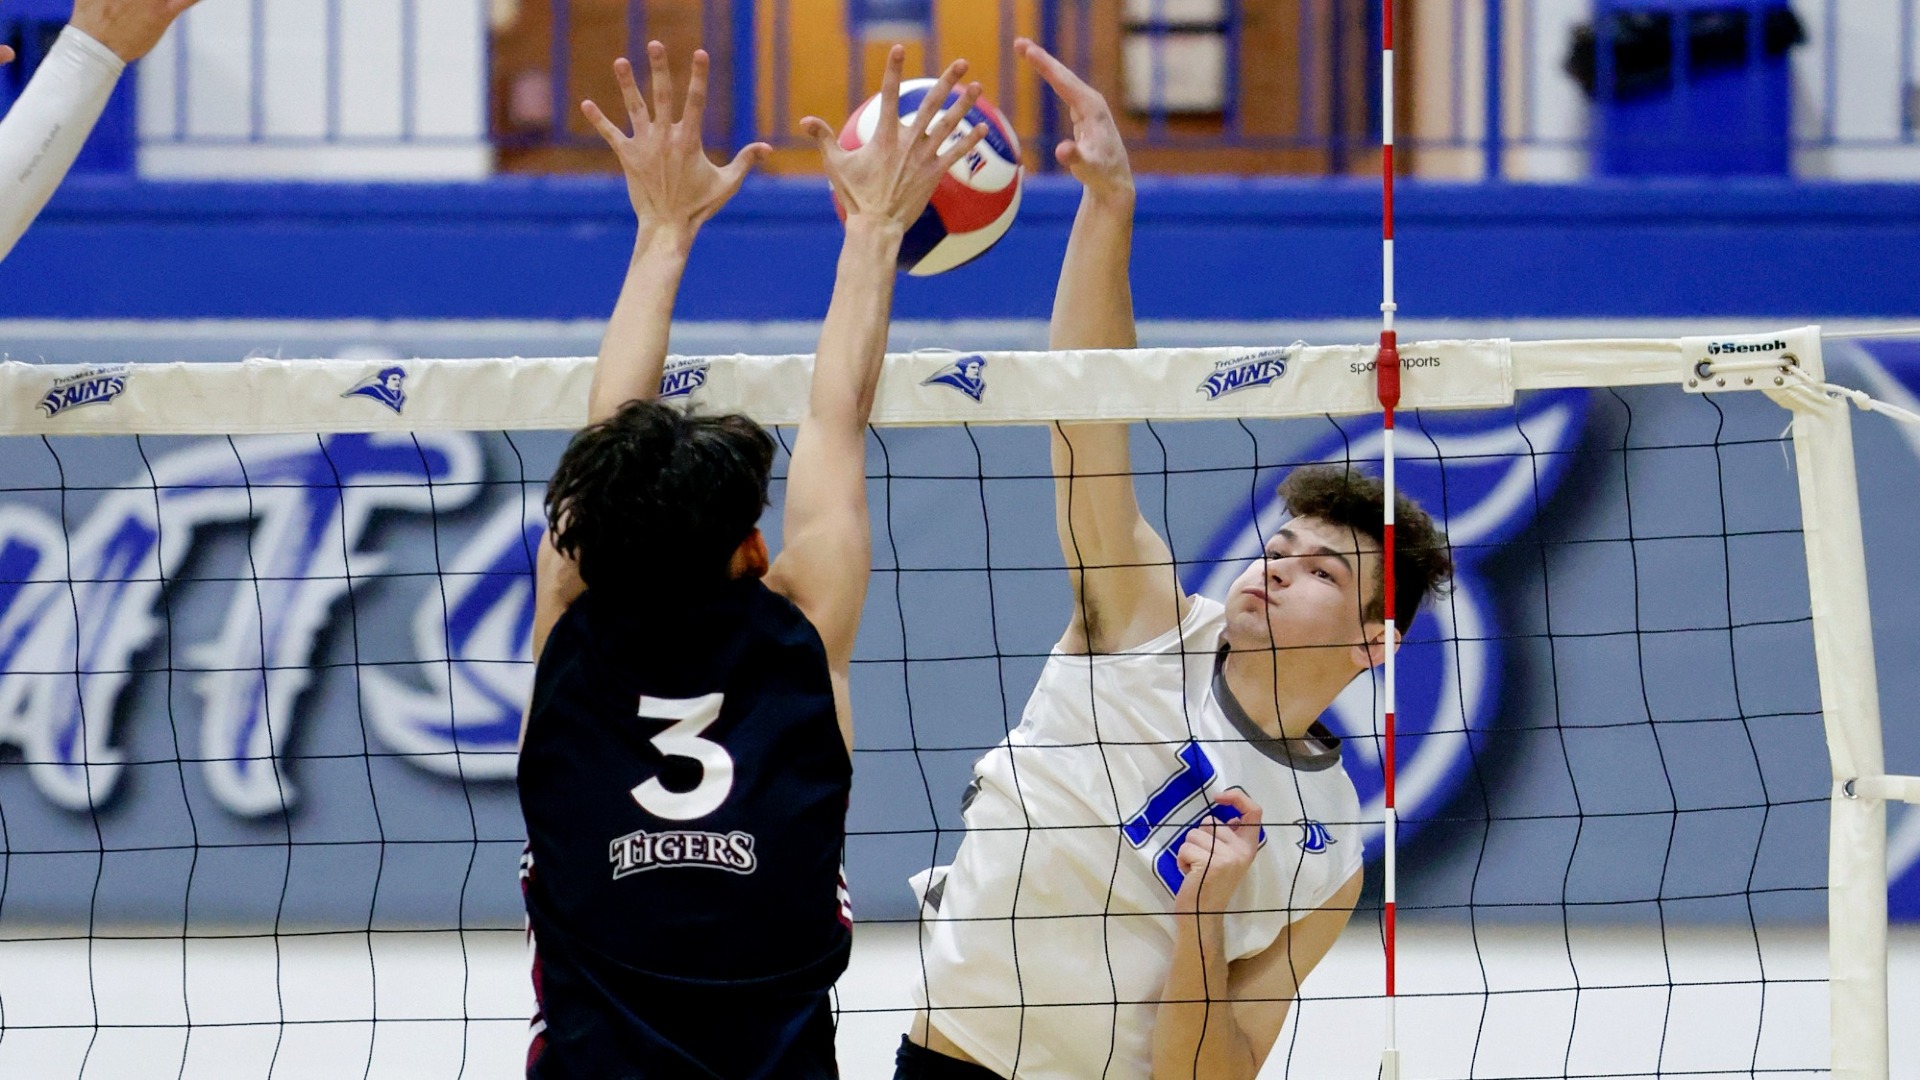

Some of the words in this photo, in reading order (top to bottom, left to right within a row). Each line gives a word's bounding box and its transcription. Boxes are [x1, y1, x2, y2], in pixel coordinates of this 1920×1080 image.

[1214, 351, 1256, 370] THOMAS
[1258, 347, 1286, 359] MORE
[1721, 340, 1787, 354] Senoh
[36, 376, 130, 418] SAINTS
[659, 364, 710, 397] INTS
[1196, 355, 1291, 401] SAINTS
[630, 692, 734, 821] 3
[611, 831, 757, 878] TIGERS
